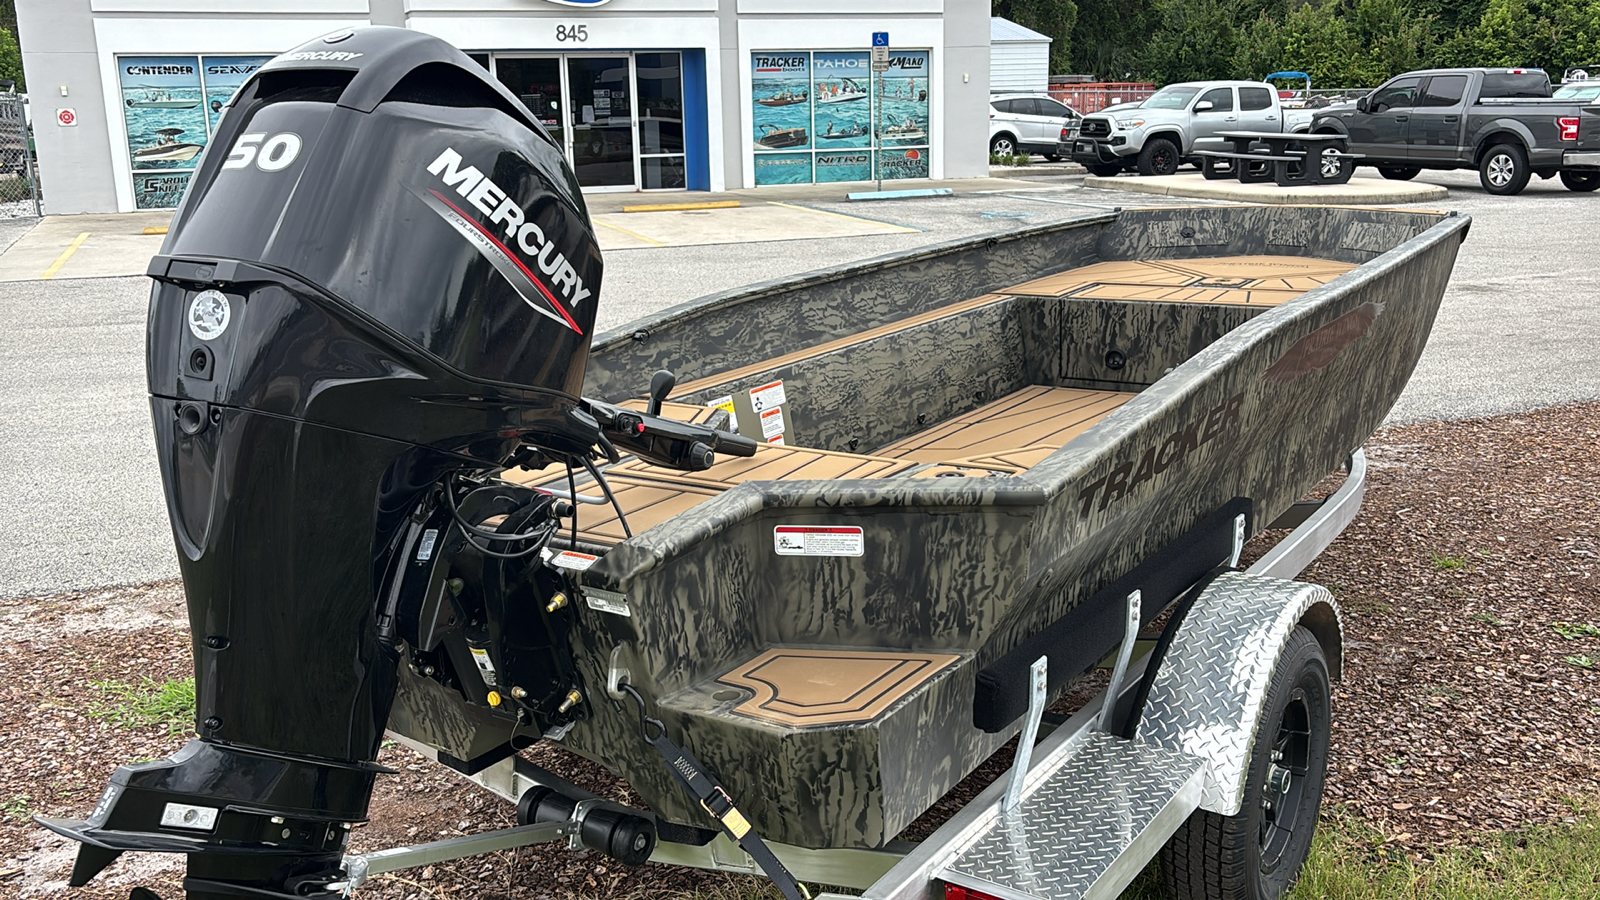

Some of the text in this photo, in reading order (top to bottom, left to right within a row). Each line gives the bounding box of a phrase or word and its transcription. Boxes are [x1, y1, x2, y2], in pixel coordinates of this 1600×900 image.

[556, 25, 588, 42] 845
[756, 57, 805, 68] TRACKER
[814, 59, 868, 68] TAHOE
[892, 56, 924, 69] MAKO
[126, 65, 194, 76] CONTENDER
[221, 131, 303, 173] 50
[817, 155, 868, 164] NITRO
[426, 146, 592, 308] MERCURY
[447, 211, 514, 268] FOURSTROKE
[1077, 392, 1245, 521] TRACKER
